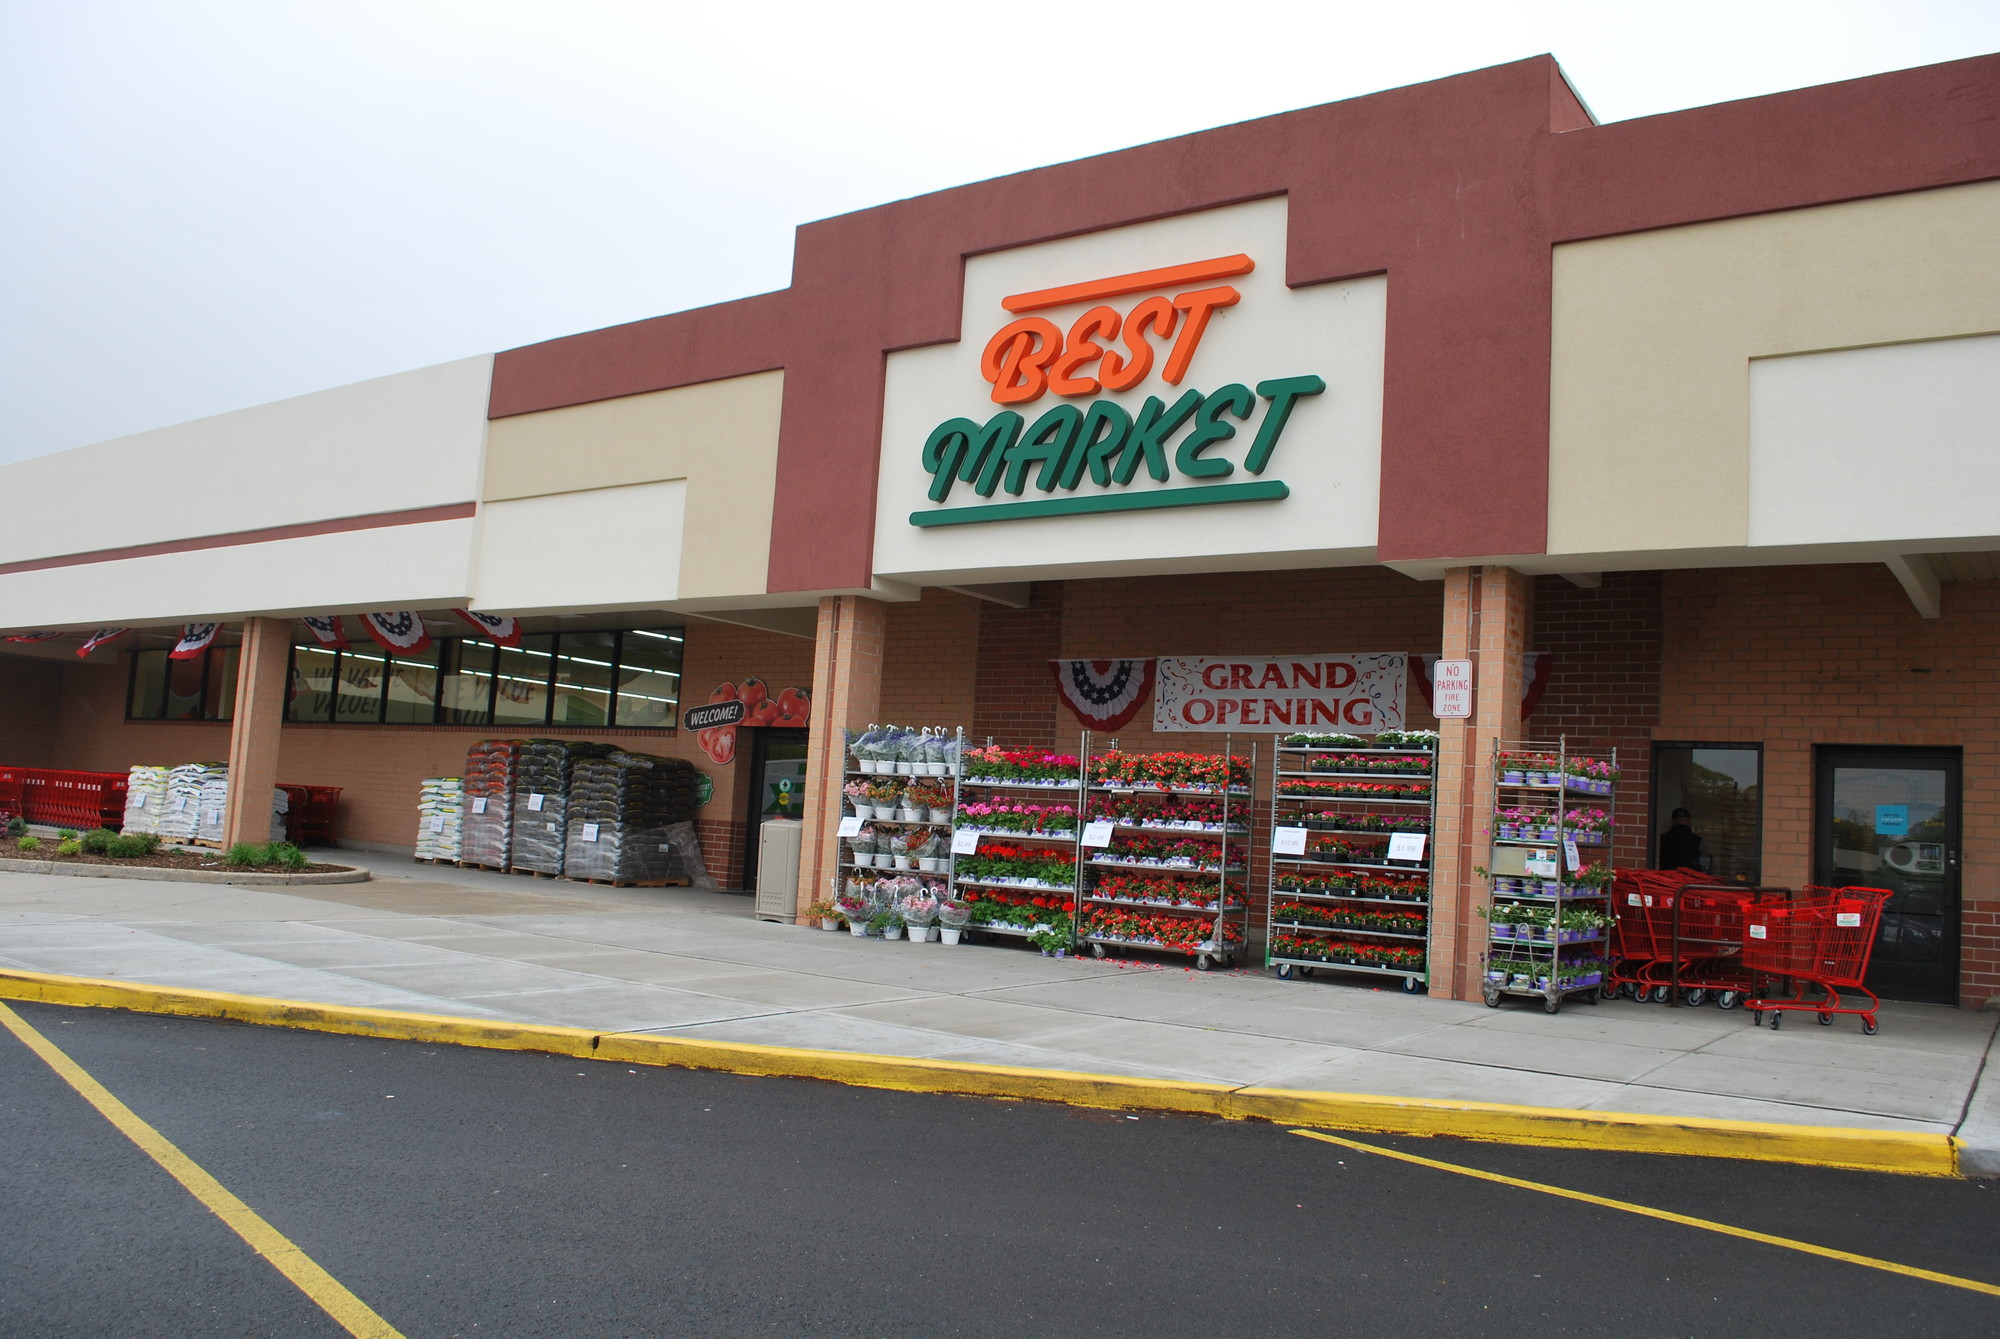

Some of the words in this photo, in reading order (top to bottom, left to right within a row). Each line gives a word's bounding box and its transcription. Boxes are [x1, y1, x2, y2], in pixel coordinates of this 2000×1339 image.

[980, 285, 1241, 405] BEST
[922, 374, 1326, 503] MARKET
[1201, 661, 1357, 691] GRAND
[1446, 665, 1460, 677] NO
[1437, 680, 1469, 691] PARKING
[1445, 693, 1460, 701] FIRE
[690, 705, 738, 726] WELCOME!
[1182, 697, 1373, 727] OPENING
[1396, 844, 1416, 853] $1.99
